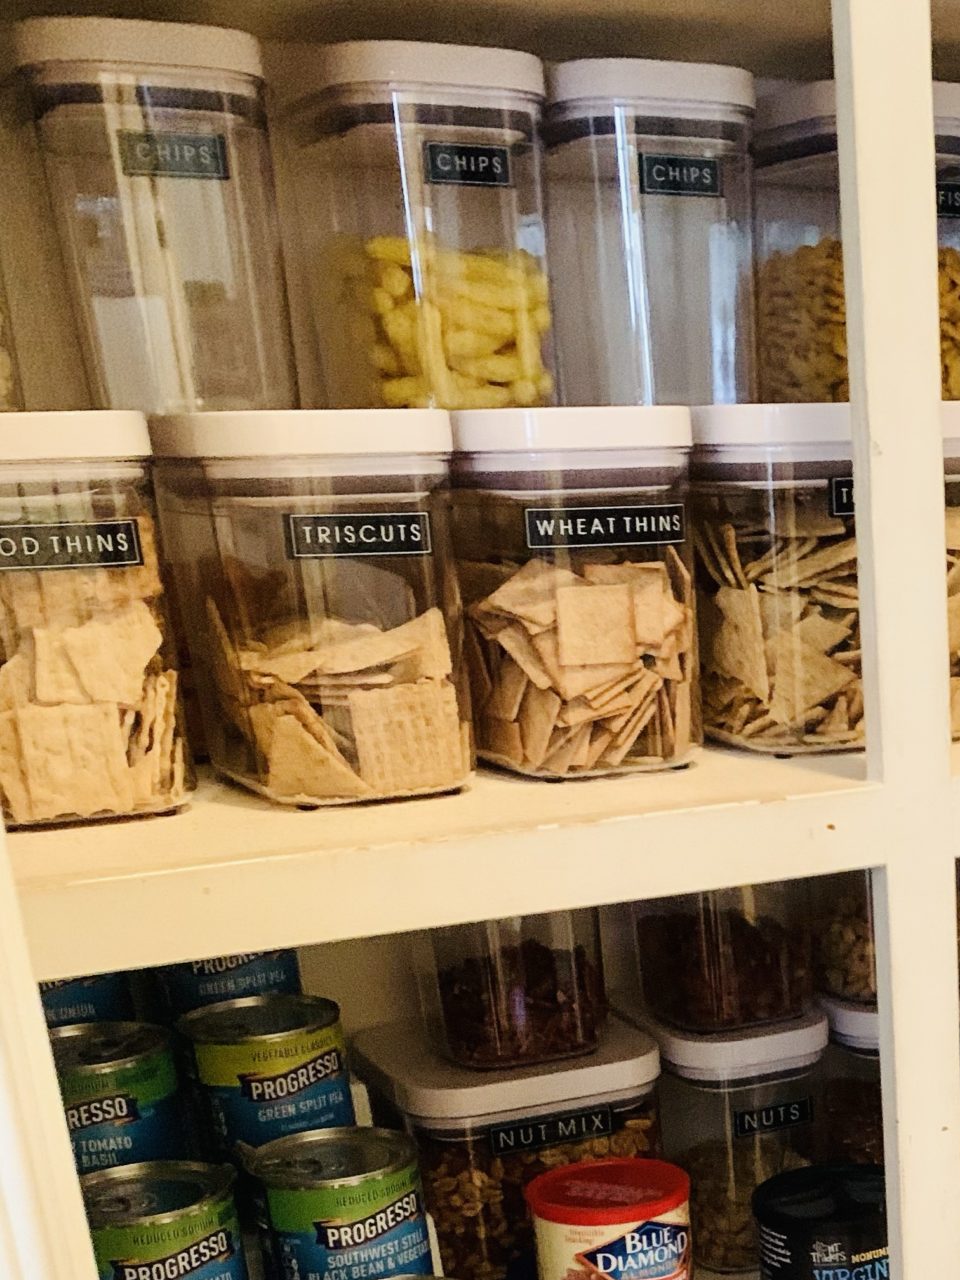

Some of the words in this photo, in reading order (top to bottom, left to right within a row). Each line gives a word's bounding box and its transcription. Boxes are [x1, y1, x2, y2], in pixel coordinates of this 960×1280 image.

[135, 141, 212, 166] CHIPS
[436, 152, 502, 174] CHIPS
[651, 163, 713, 184] CHIPS
[301, 523, 422, 545] TRISCUTS
[535, 517, 616, 537] WHEAT
[622, 513, 681, 534] THINS
[0, 536, 40, 557] OD
[49, 532, 130, 554] THINS
[251, 1052, 340, 1101] PROGRESSO
[68, 1097, 128, 1129] RESSO
[257, 1104, 297, 1123] GREEN
[743, 1104, 801, 1131] NUTS
[498, 1124, 548, 1149] NUT
[558, 1113, 605, 1137] MIX
[80, 1136, 133, 1153] TOMATO
[81, 1152, 119, 1168] BASIL
[326, 1193, 418, 1248] PROGRESSO
[596, 1231, 688, 1273] DIAMOND
[624, 1226, 673, 1254] BLUE
[327, 1240, 400, 1269] SOUTHWEST
[351, 1261, 386, 1280] BEAN
